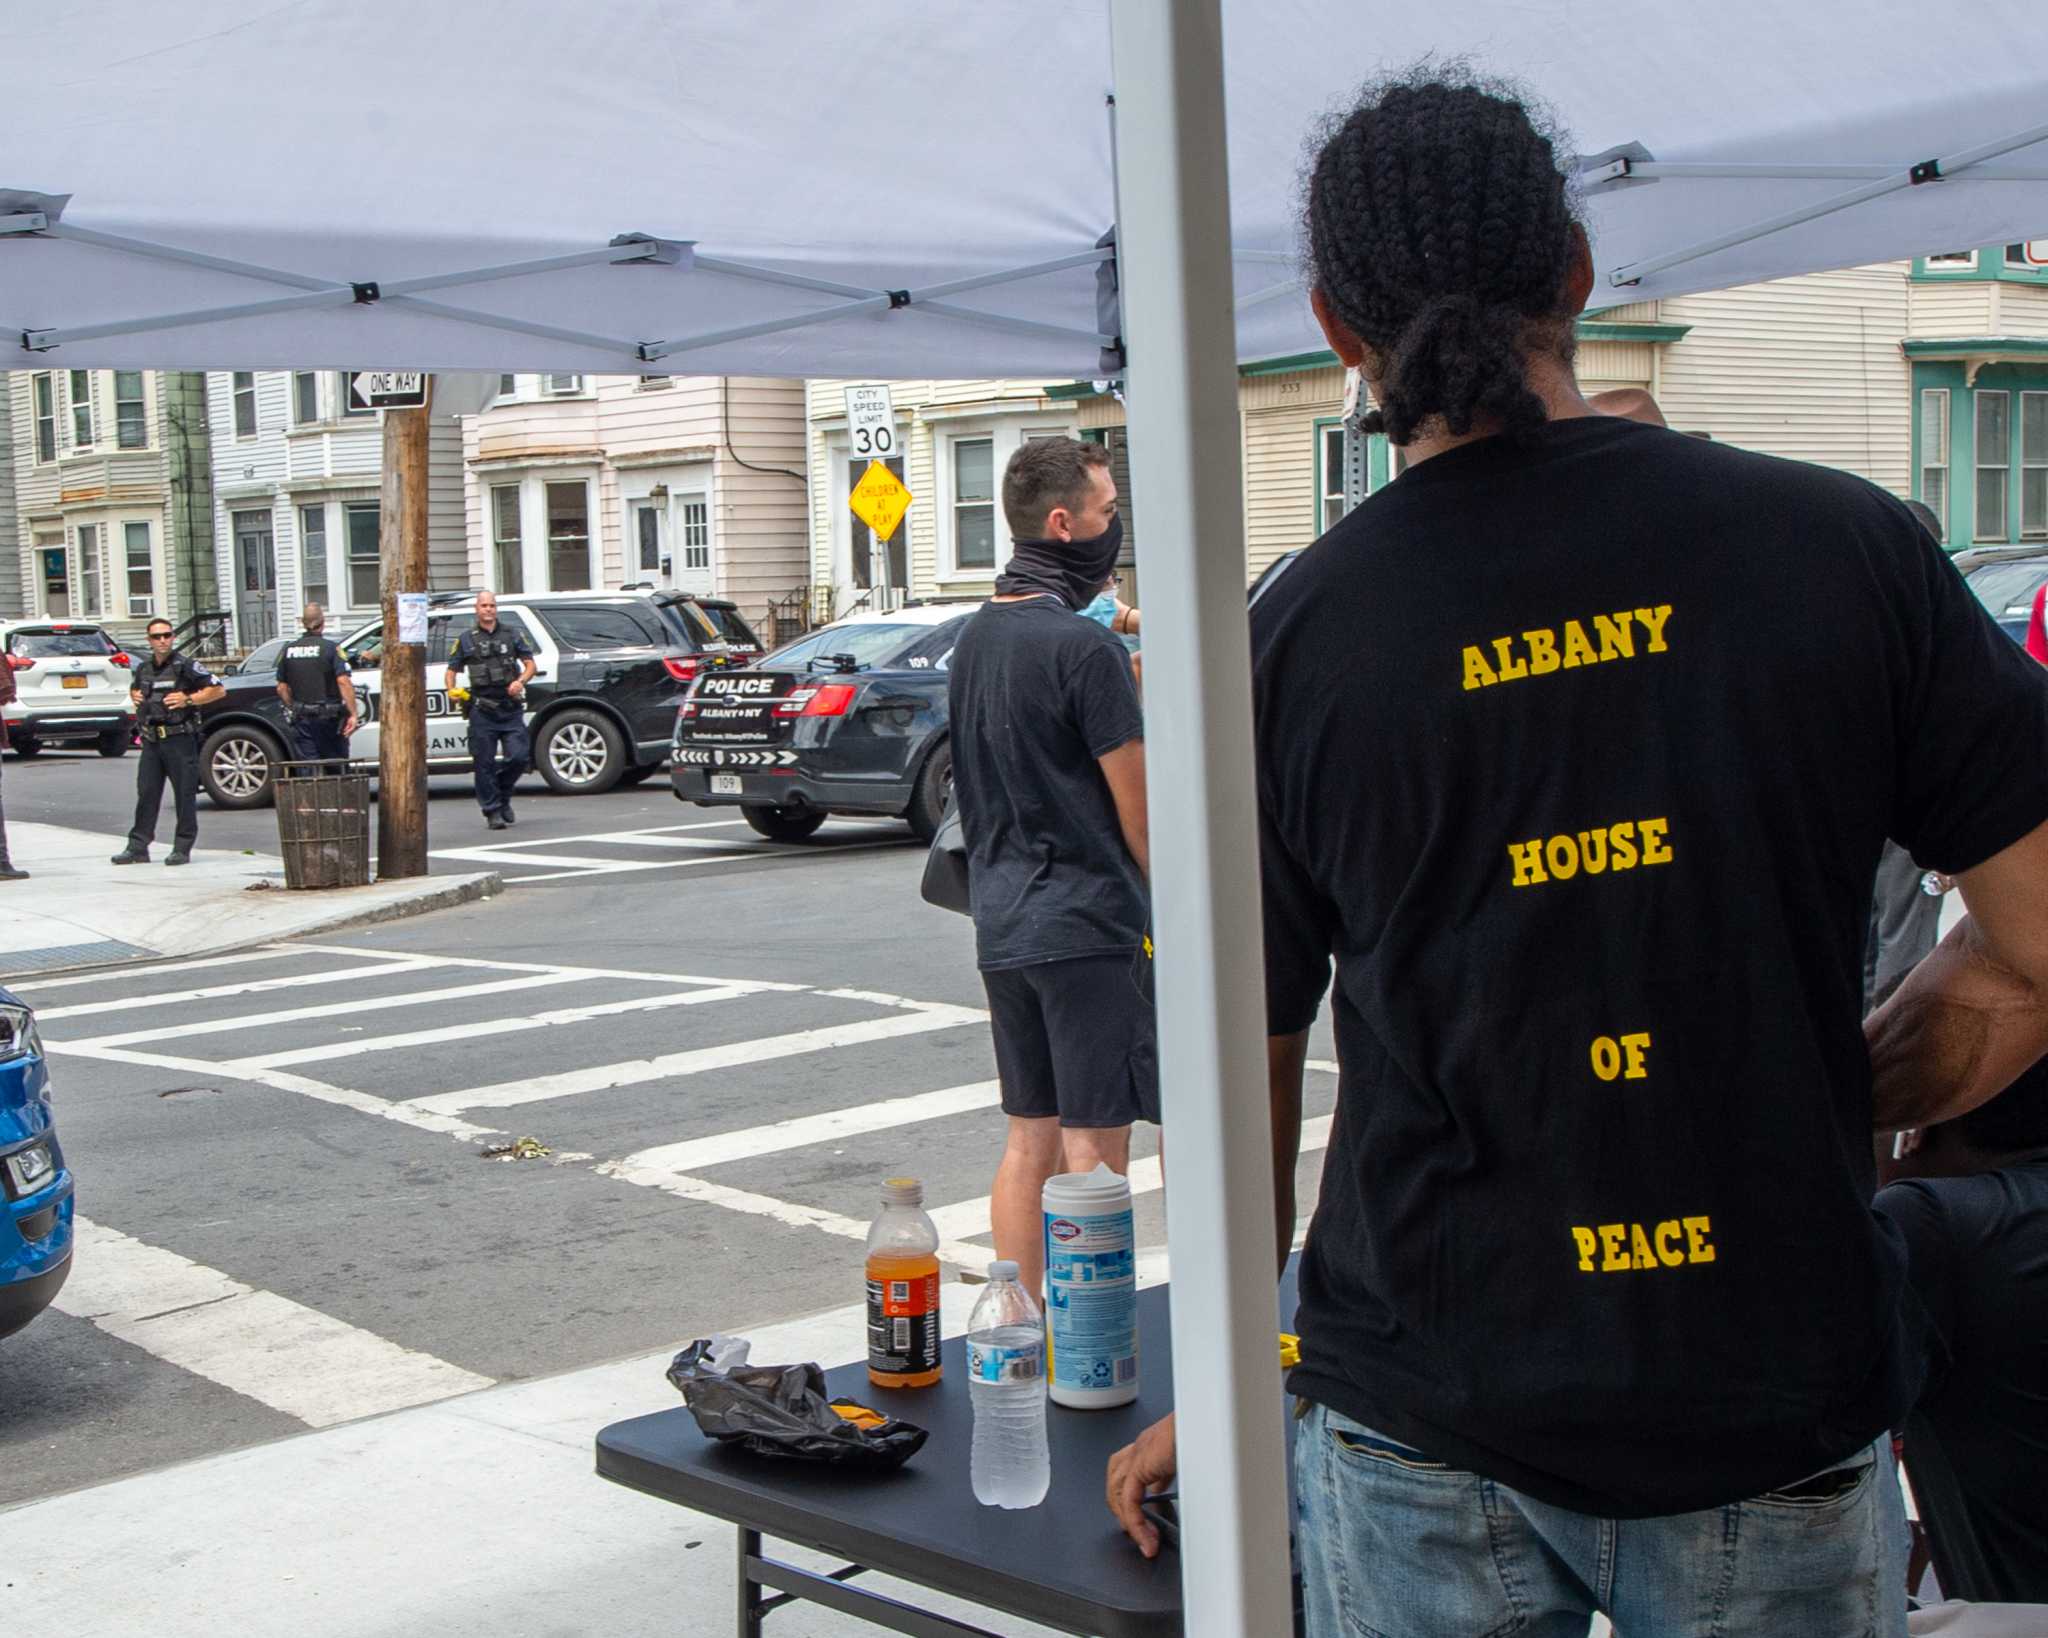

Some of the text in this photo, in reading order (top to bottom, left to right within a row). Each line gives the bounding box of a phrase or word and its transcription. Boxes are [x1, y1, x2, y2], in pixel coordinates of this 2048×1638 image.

[371, 372, 416, 392] ONE WAY
[857, 390, 878, 400] CITY
[853, 402, 886, 412] SPEED
[858, 414, 884, 424] LIMIT
[856, 427, 892, 453] 30
[286, 645, 320, 659] POLICE
[1462, 604, 1673, 691] ALBANY
[908, 656, 929, 668] 109
[704, 679, 775, 694] POLICE
[1507, 817, 1673, 887] HOUSE
[1590, 1032, 1652, 1081] OF
[1571, 1215, 1715, 1272] PEACE
